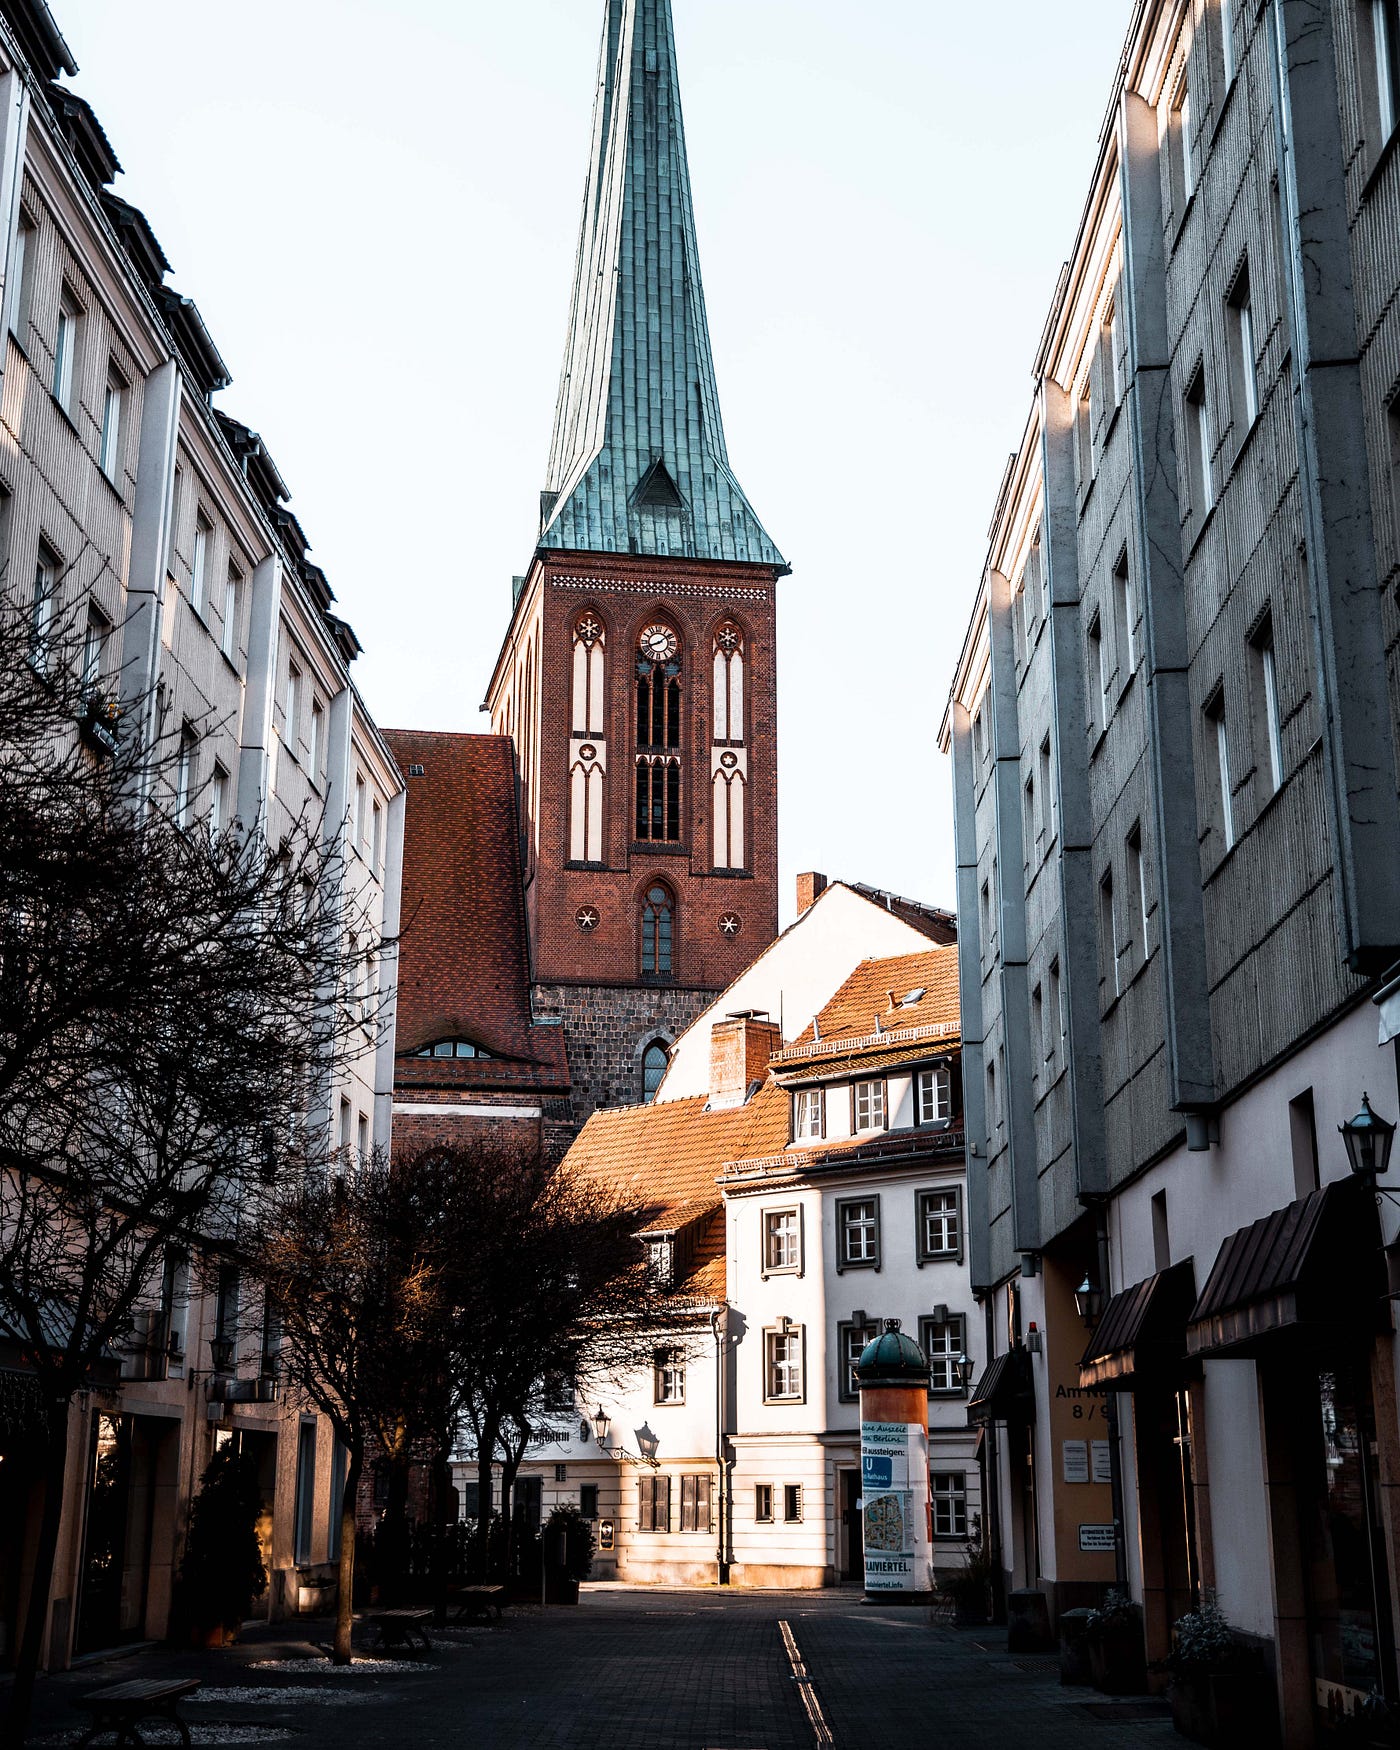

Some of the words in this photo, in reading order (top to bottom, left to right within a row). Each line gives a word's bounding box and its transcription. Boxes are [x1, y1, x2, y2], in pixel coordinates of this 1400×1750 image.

[1056, 1384, 1081, 1398] Am
[1073, 1404, 1083, 1419] 8
[876, 1424, 906, 1433] Auszeit
[868, 1447, 905, 1457] aussteigen:
[866, 1458, 873, 1471] U
